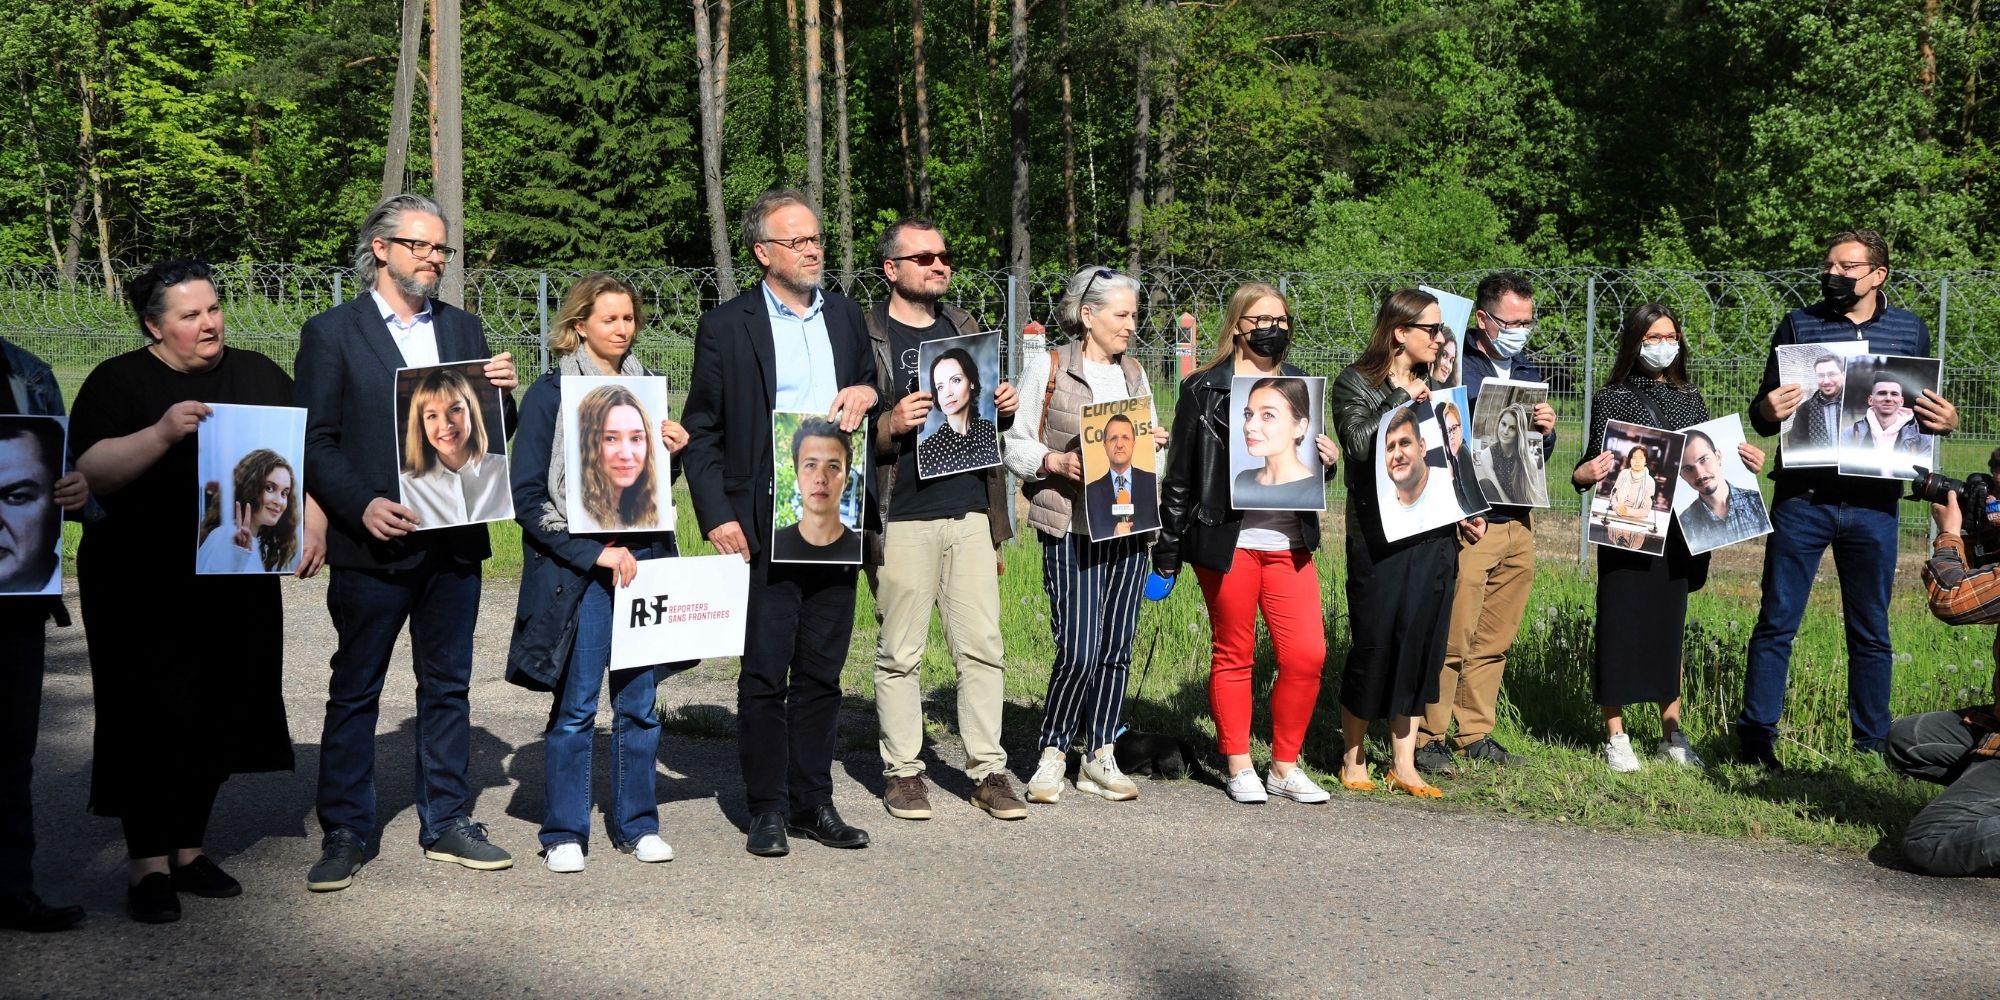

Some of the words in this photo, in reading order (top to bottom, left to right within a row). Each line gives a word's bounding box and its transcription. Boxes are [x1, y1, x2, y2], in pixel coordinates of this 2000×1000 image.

[630, 594, 668, 628] RSF
[668, 603, 708, 613] REPORTERS
[668, 614, 687, 623] SANS
